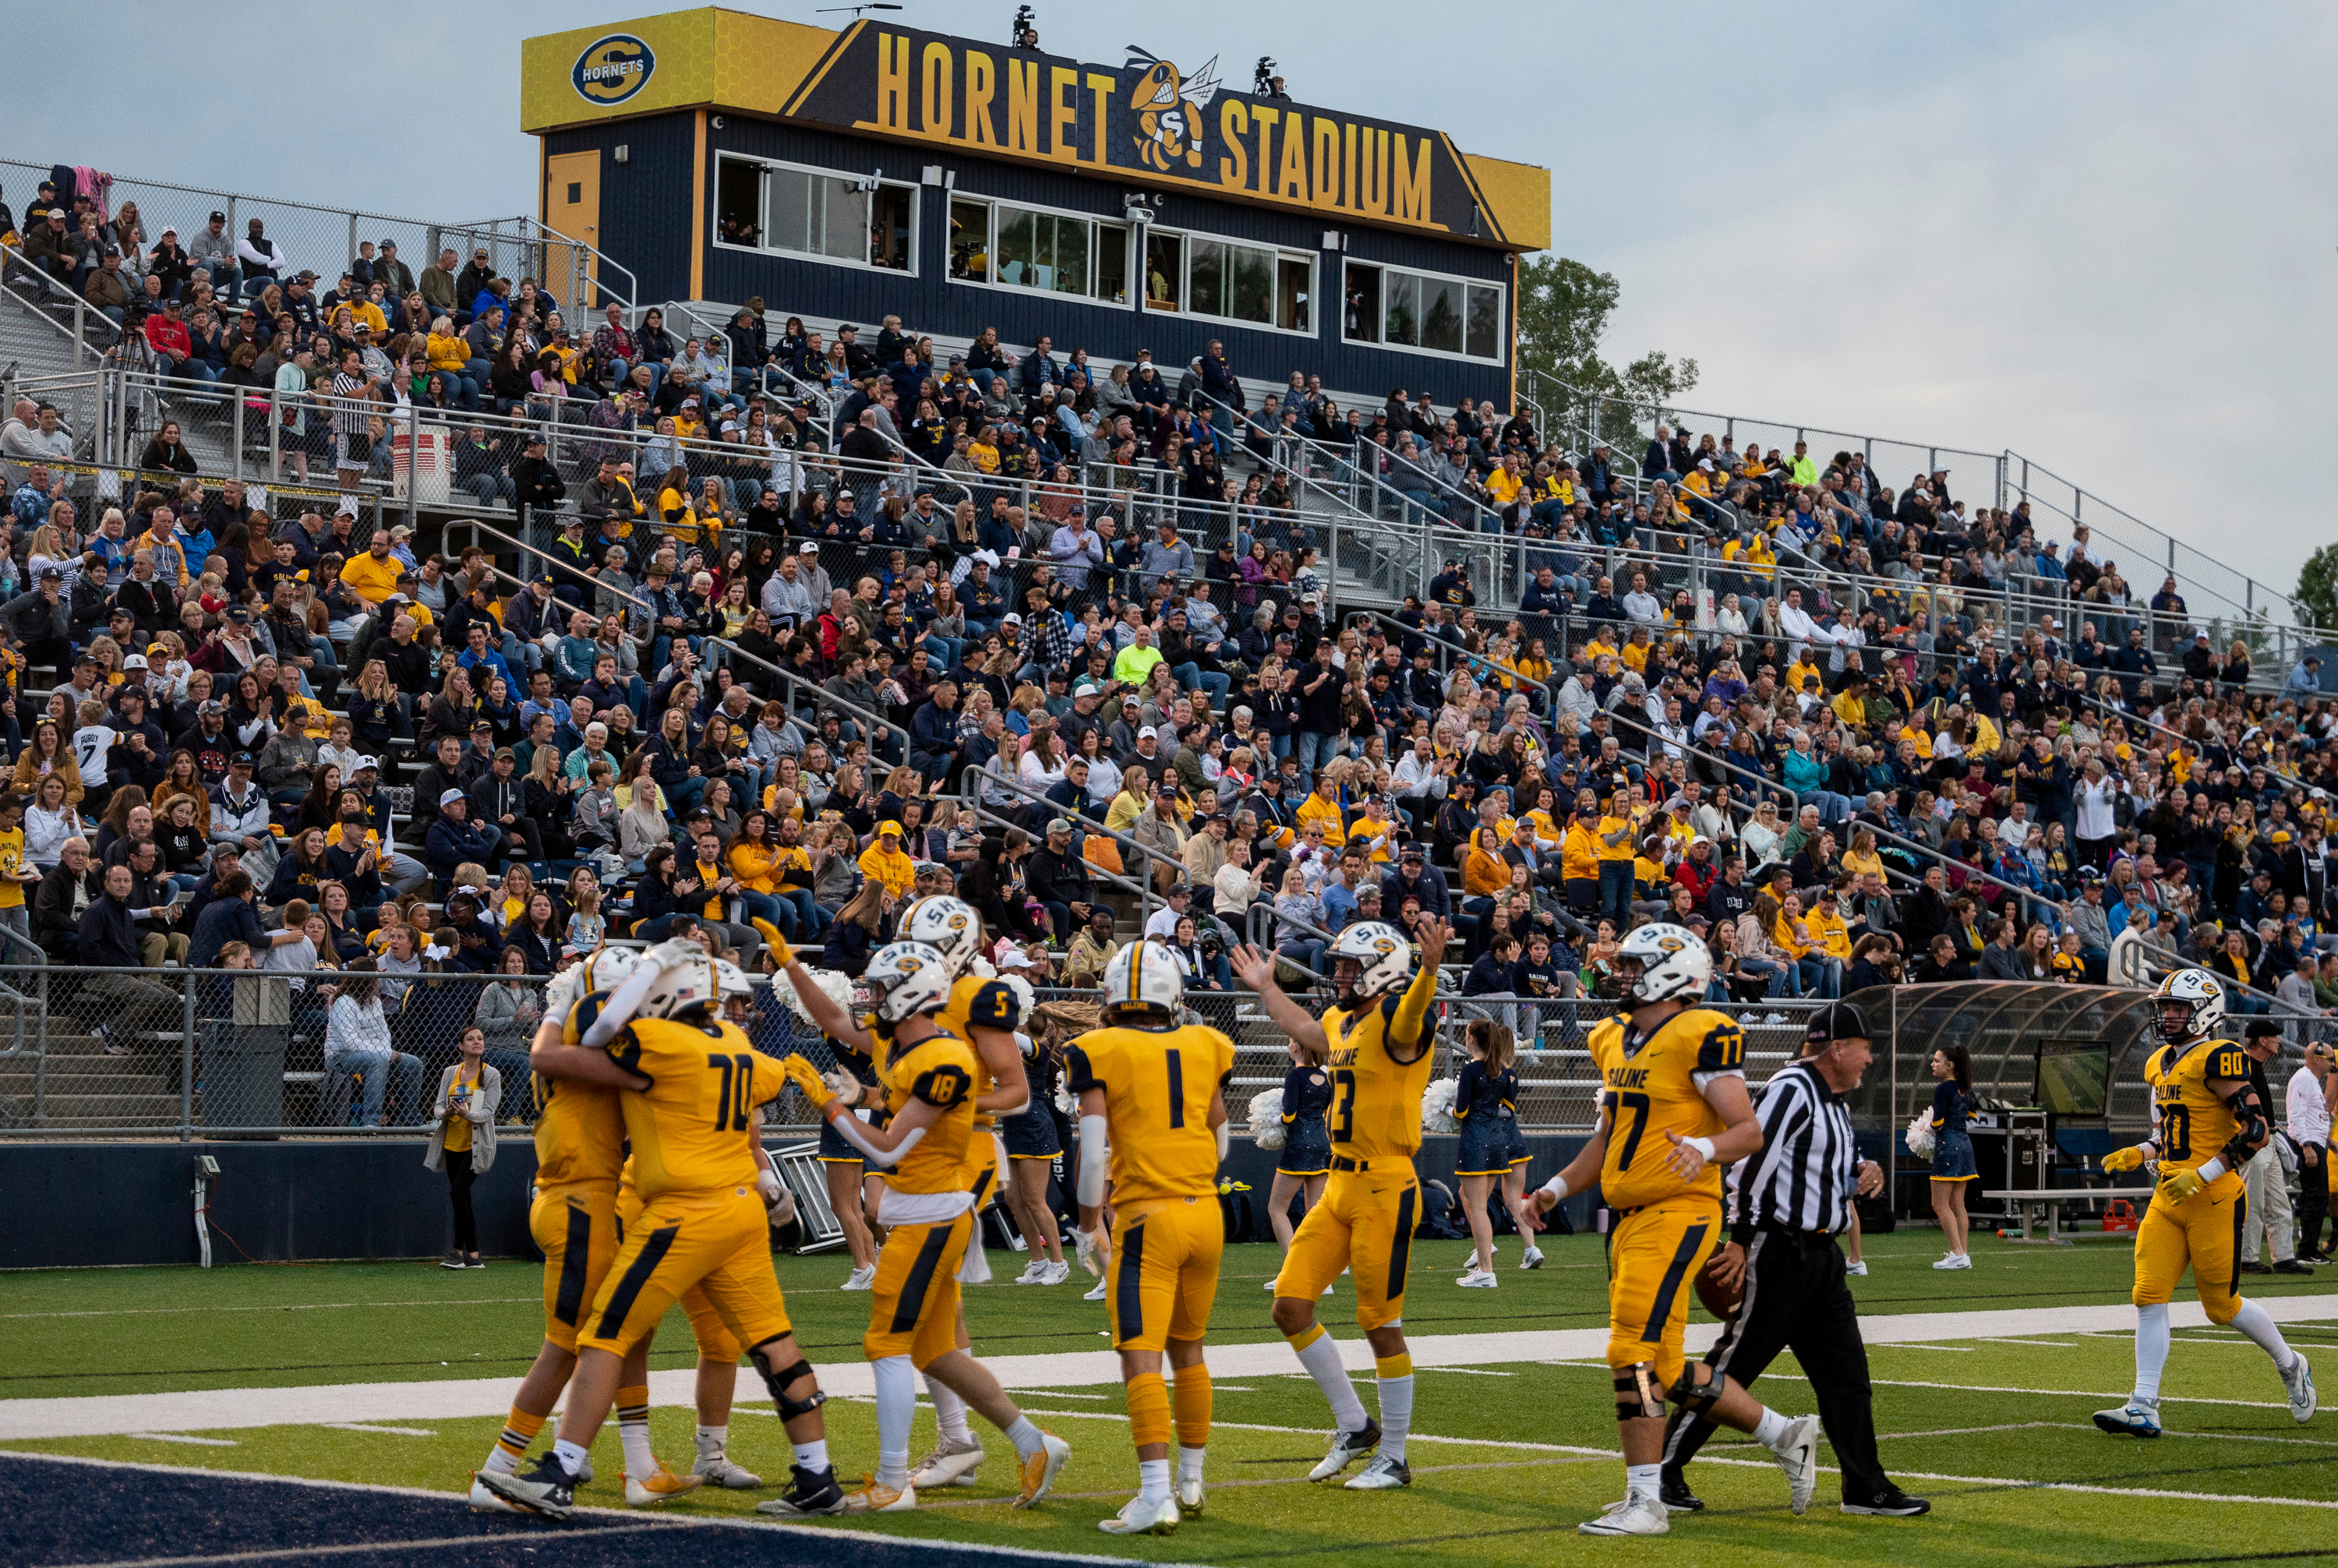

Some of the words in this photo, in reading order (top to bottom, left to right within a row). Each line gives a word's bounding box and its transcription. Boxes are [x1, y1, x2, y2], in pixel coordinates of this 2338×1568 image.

[582, 58, 644, 82] HORNETS
[878, 33, 1115, 165] HORNET
[1220, 99, 1432, 224] STADIUM
[1161, 110, 1184, 136] S
[545, 574, 553, 583] M
[962, 682, 984, 690] SALINE
[80, 734, 98, 744] PURDY
[83, 745, 96, 768] 7
[926, 899, 969, 925] SHS
[1356, 924, 1404, 945] SHS
[1639, 926, 1700, 948] SHS
[880, 944, 937, 964] SHS
[2184, 971, 2210, 987] SH
[994, 991, 1008, 1017] 5
[1121, 1002, 1148, 1012] SALINE
[1716, 1033, 1742, 1066] 77
[2220, 1052, 2242, 1076] 80
[929, 1074, 956, 1103] 18
[1166, 1049, 1185, 1129] 1
[1608, 1068, 1650, 1089] SALINE
[708, 1053, 754, 1132] 70
[1602, 1092, 1650, 1171] 77
